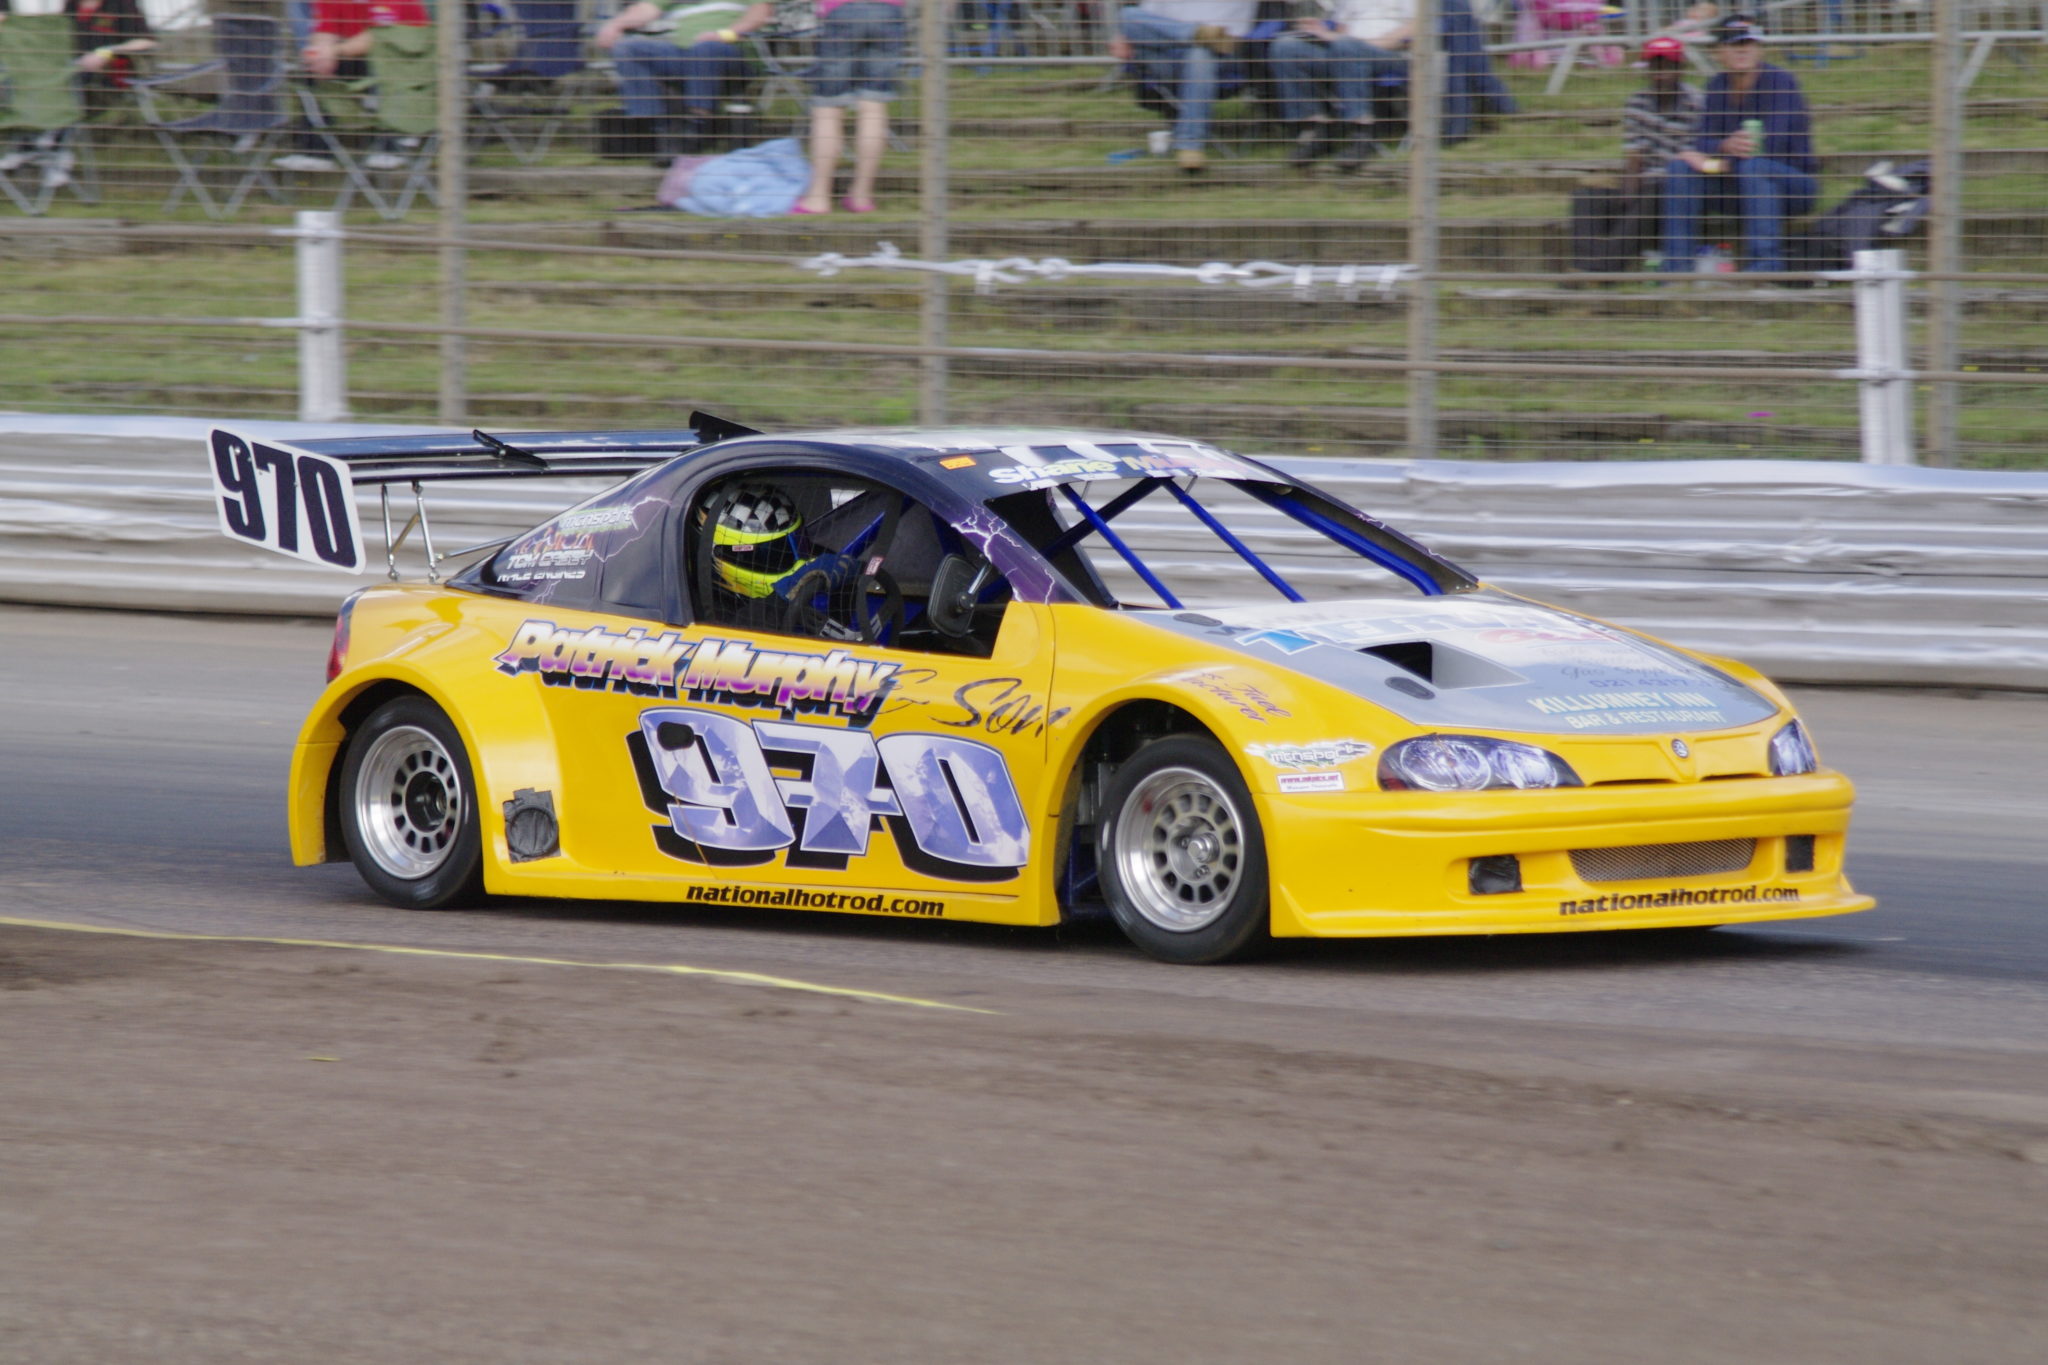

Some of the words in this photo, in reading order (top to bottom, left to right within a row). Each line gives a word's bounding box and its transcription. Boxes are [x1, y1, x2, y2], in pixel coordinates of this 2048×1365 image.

[989, 459, 1117, 484] Shane
[211, 428, 357, 569] 970
[493, 620, 698, 692] Patrick
[683, 638, 902, 720] Murphy
[928, 677, 1072, 738] Son
[1664, 691, 1718, 709] INN
[1564, 712, 1604, 730] BAR
[1606, 711, 1625, 726] &
[1619, 710, 1728, 726] RESTAURANT
[633, 706, 1032, 874] 970
[686, 884, 945, 917] nationalhotrod.com
[1559, 885, 1800, 916] nationalhotrod.com
